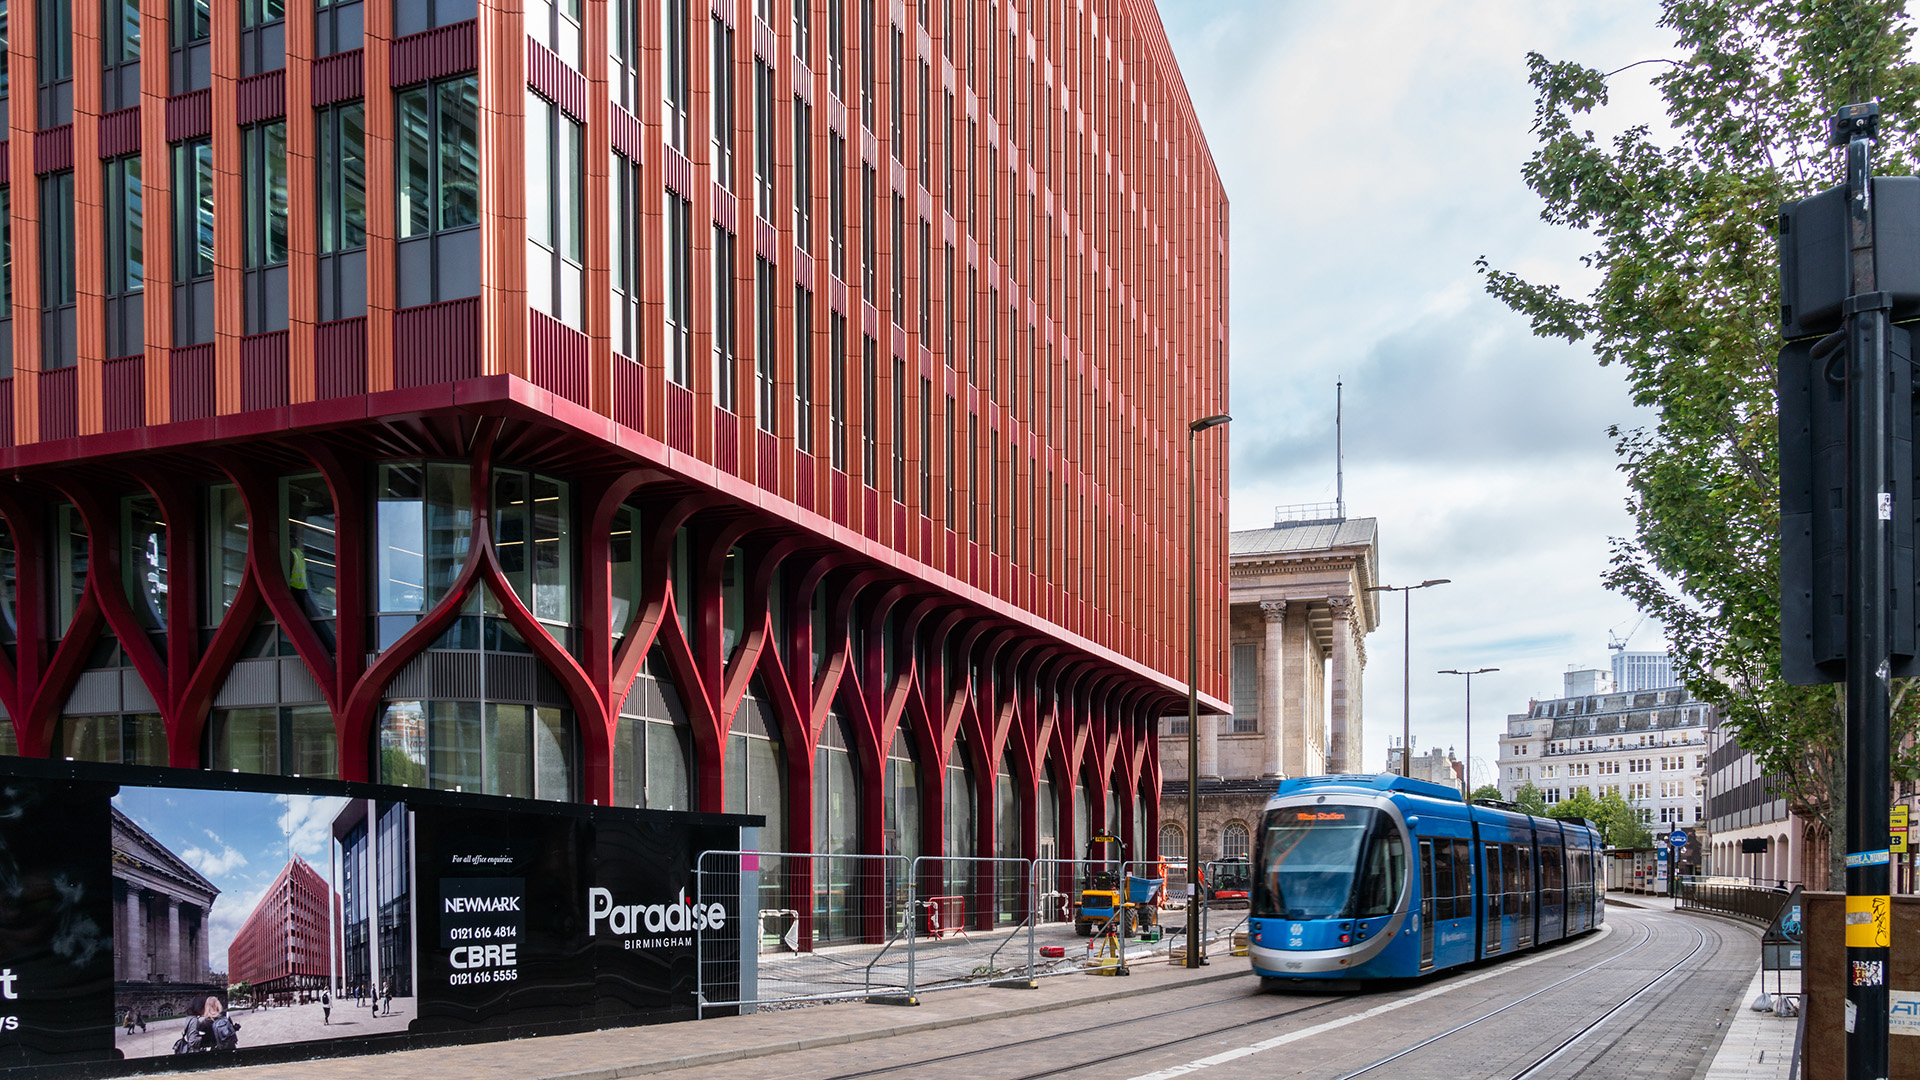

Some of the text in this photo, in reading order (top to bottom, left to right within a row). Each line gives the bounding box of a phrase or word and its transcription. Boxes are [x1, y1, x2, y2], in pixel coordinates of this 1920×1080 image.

[1317, 812, 1345, 820] Station
[452, 854, 514, 865] For all office enquiries:
[445, 896, 520, 913] NEWMARK
[589, 886, 726, 936] Paradise
[450, 925, 517, 940] 0121 616 4814
[624, 937, 692, 950] BIRMINGHAM
[449, 943, 517, 969] CBRE
[449, 969, 518, 985] 0121 616 5555
